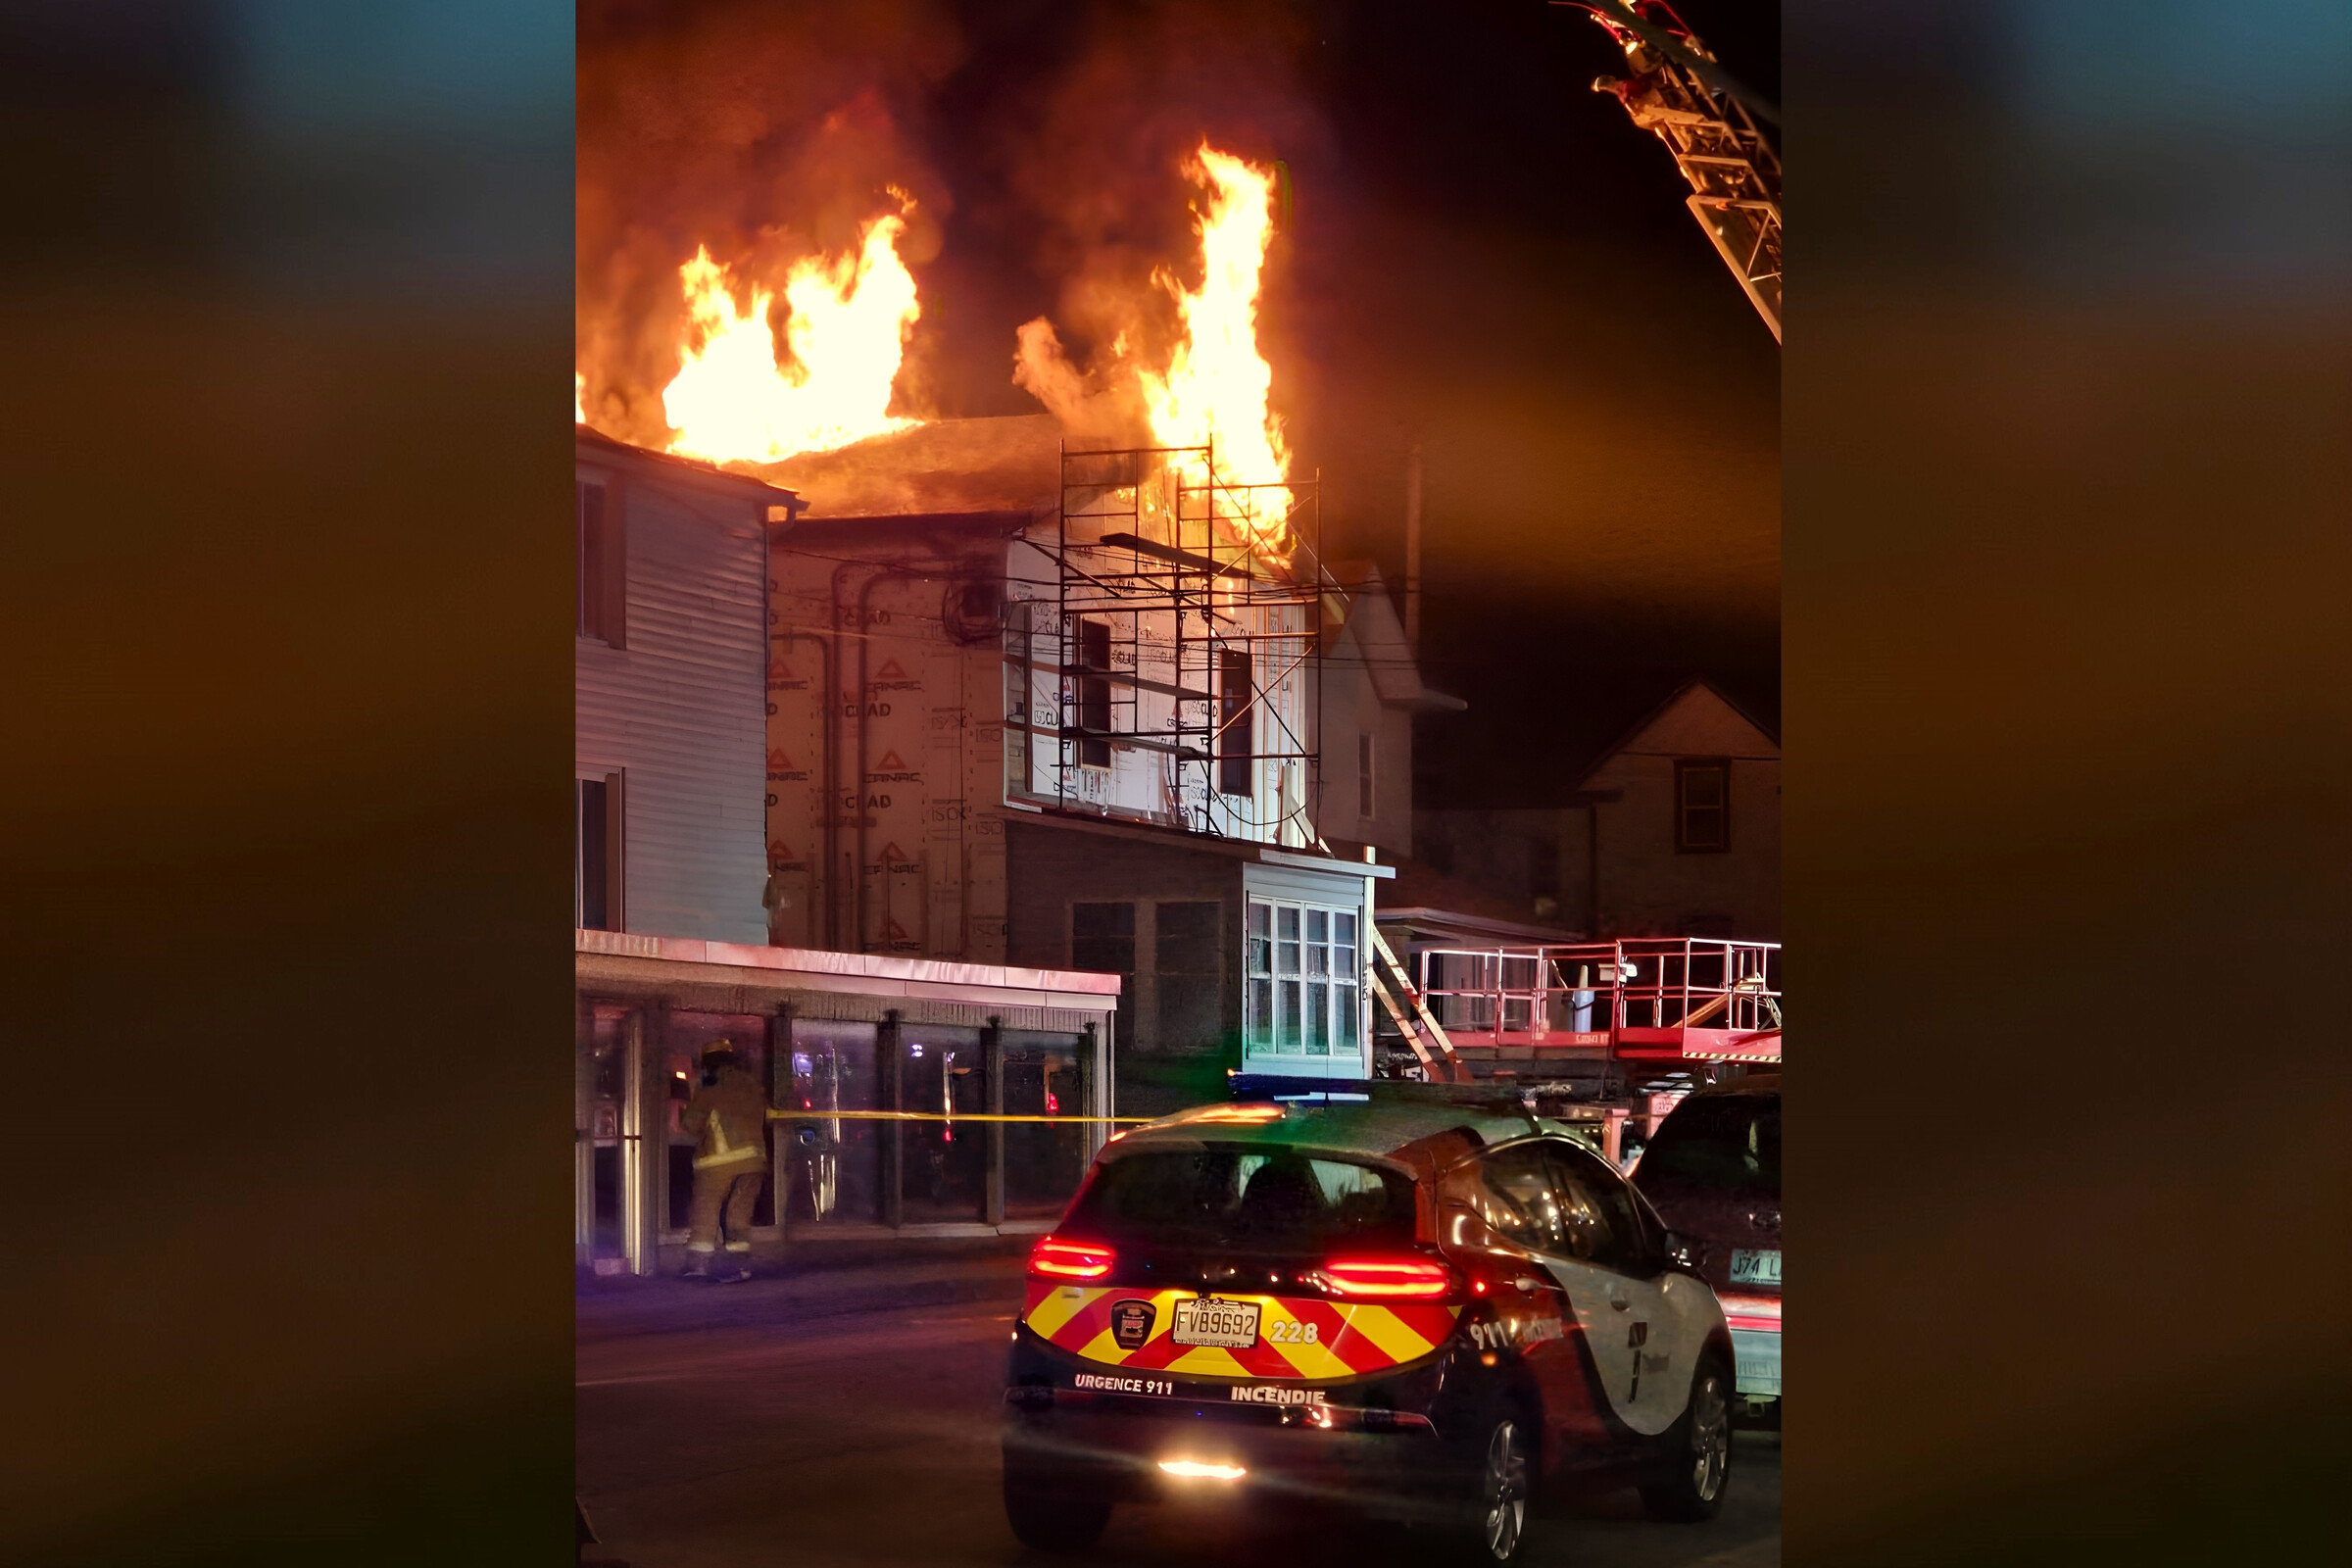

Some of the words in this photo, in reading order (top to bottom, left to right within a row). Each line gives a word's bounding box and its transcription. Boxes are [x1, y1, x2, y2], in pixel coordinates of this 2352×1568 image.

[1270, 1320, 1319, 1345] 228
[1469, 1321, 1508, 1350] 911
[1074, 1373, 1144, 1393] URGENCE
[1146, 1380, 1173, 1396] 911
[1231, 1386, 1326, 1405] INCENDIE
